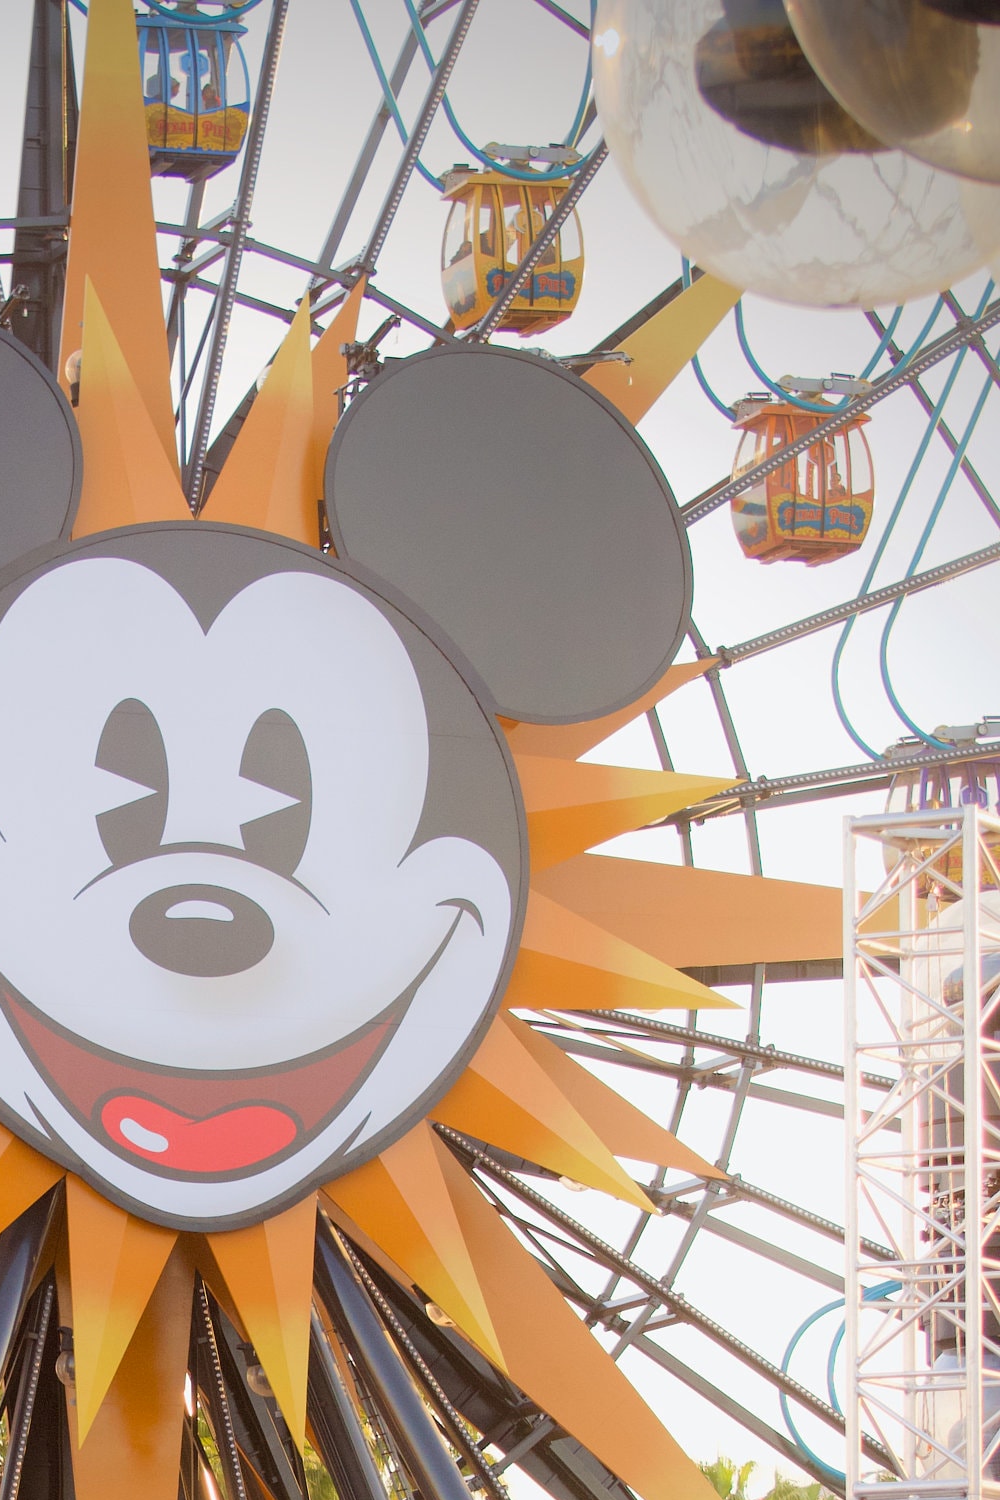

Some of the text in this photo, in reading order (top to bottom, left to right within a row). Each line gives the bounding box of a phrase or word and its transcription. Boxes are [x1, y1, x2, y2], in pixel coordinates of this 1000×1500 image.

[202, 120, 232, 141] PIER
[538, 275, 569, 295] PIER
[828, 507, 858, 529] PIER
